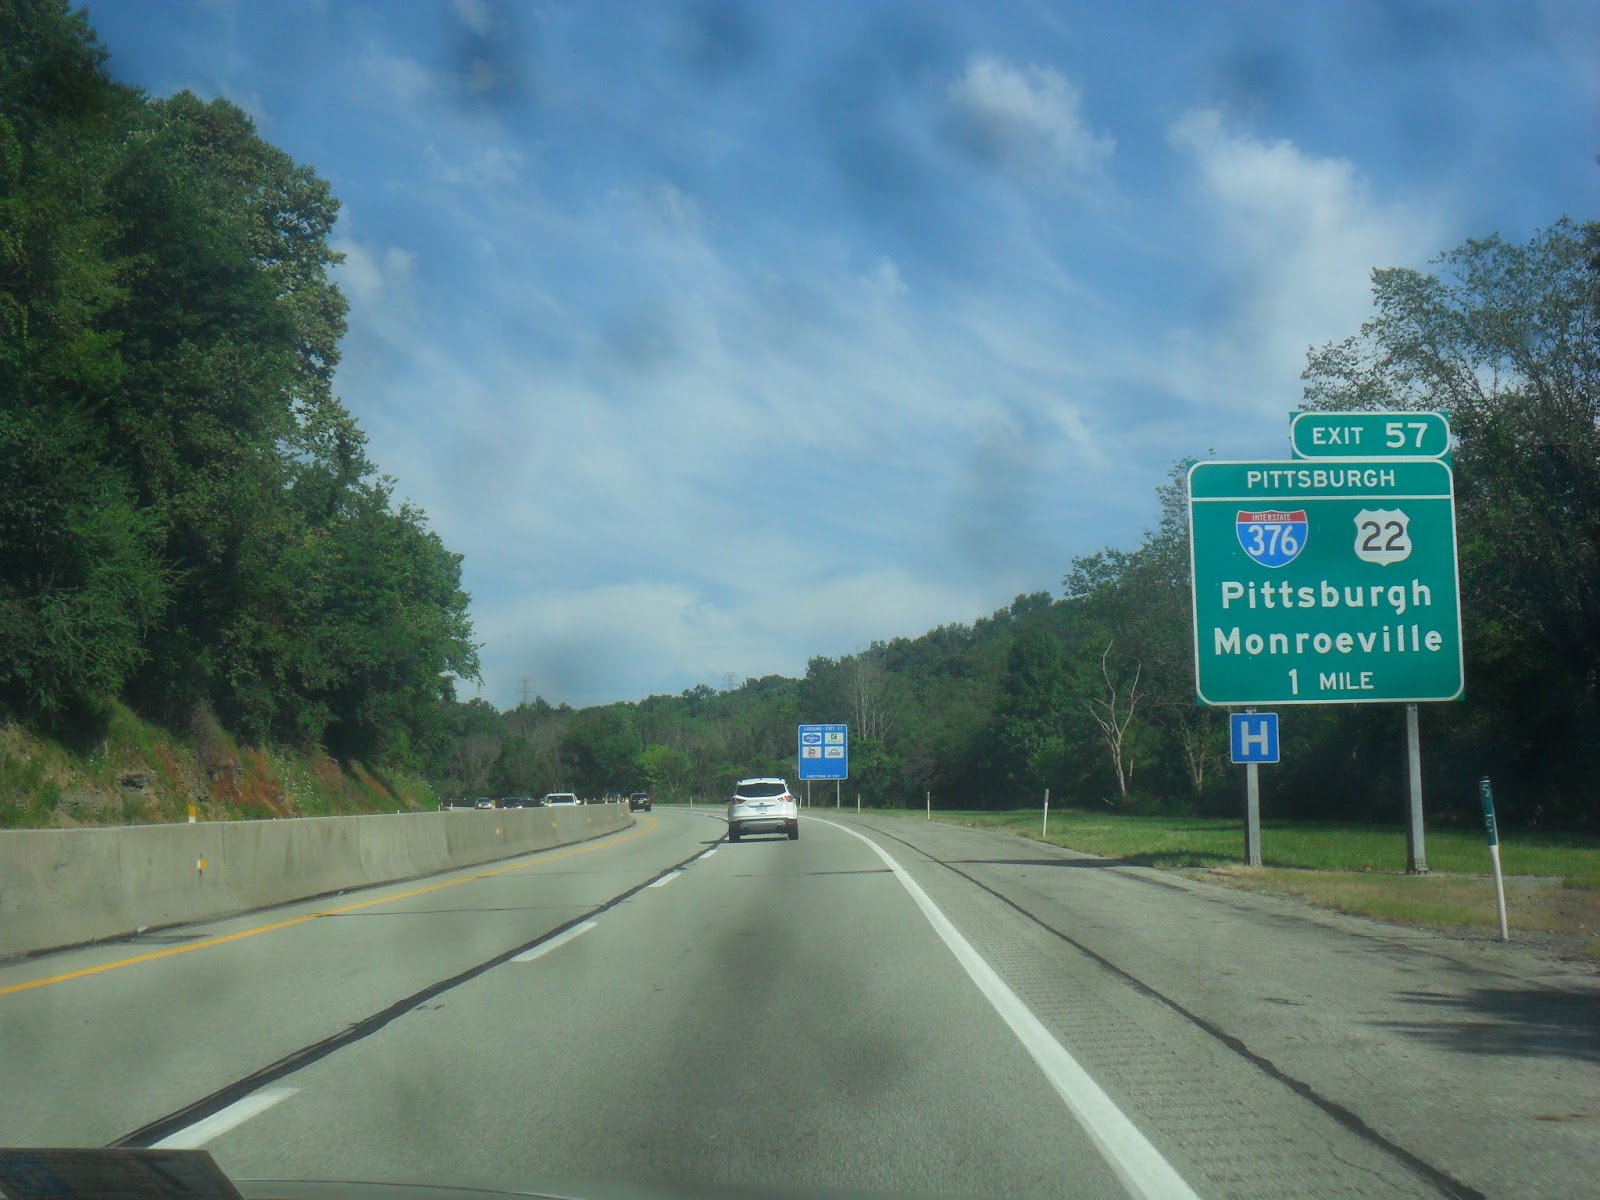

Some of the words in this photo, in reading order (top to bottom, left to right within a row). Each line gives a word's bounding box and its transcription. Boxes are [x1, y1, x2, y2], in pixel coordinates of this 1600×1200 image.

[1312, 427, 1364, 445] EXIT
[1385, 422, 1428, 448] 57
[1247, 469, 1396, 488] PITTSBURGH
[1251, 513, 1291, 522] INTERSTATE
[1247, 524, 1298, 556] 376
[1361, 520, 1405, 551] 22
[1221, 579, 1432, 615] Pittsburgh
[1214, 624, 1443, 655] Monroeville
[1288, 668, 1299, 694] 1
[1319, 672, 1374, 690] MILE
[1241, 720, 1269, 756] H
